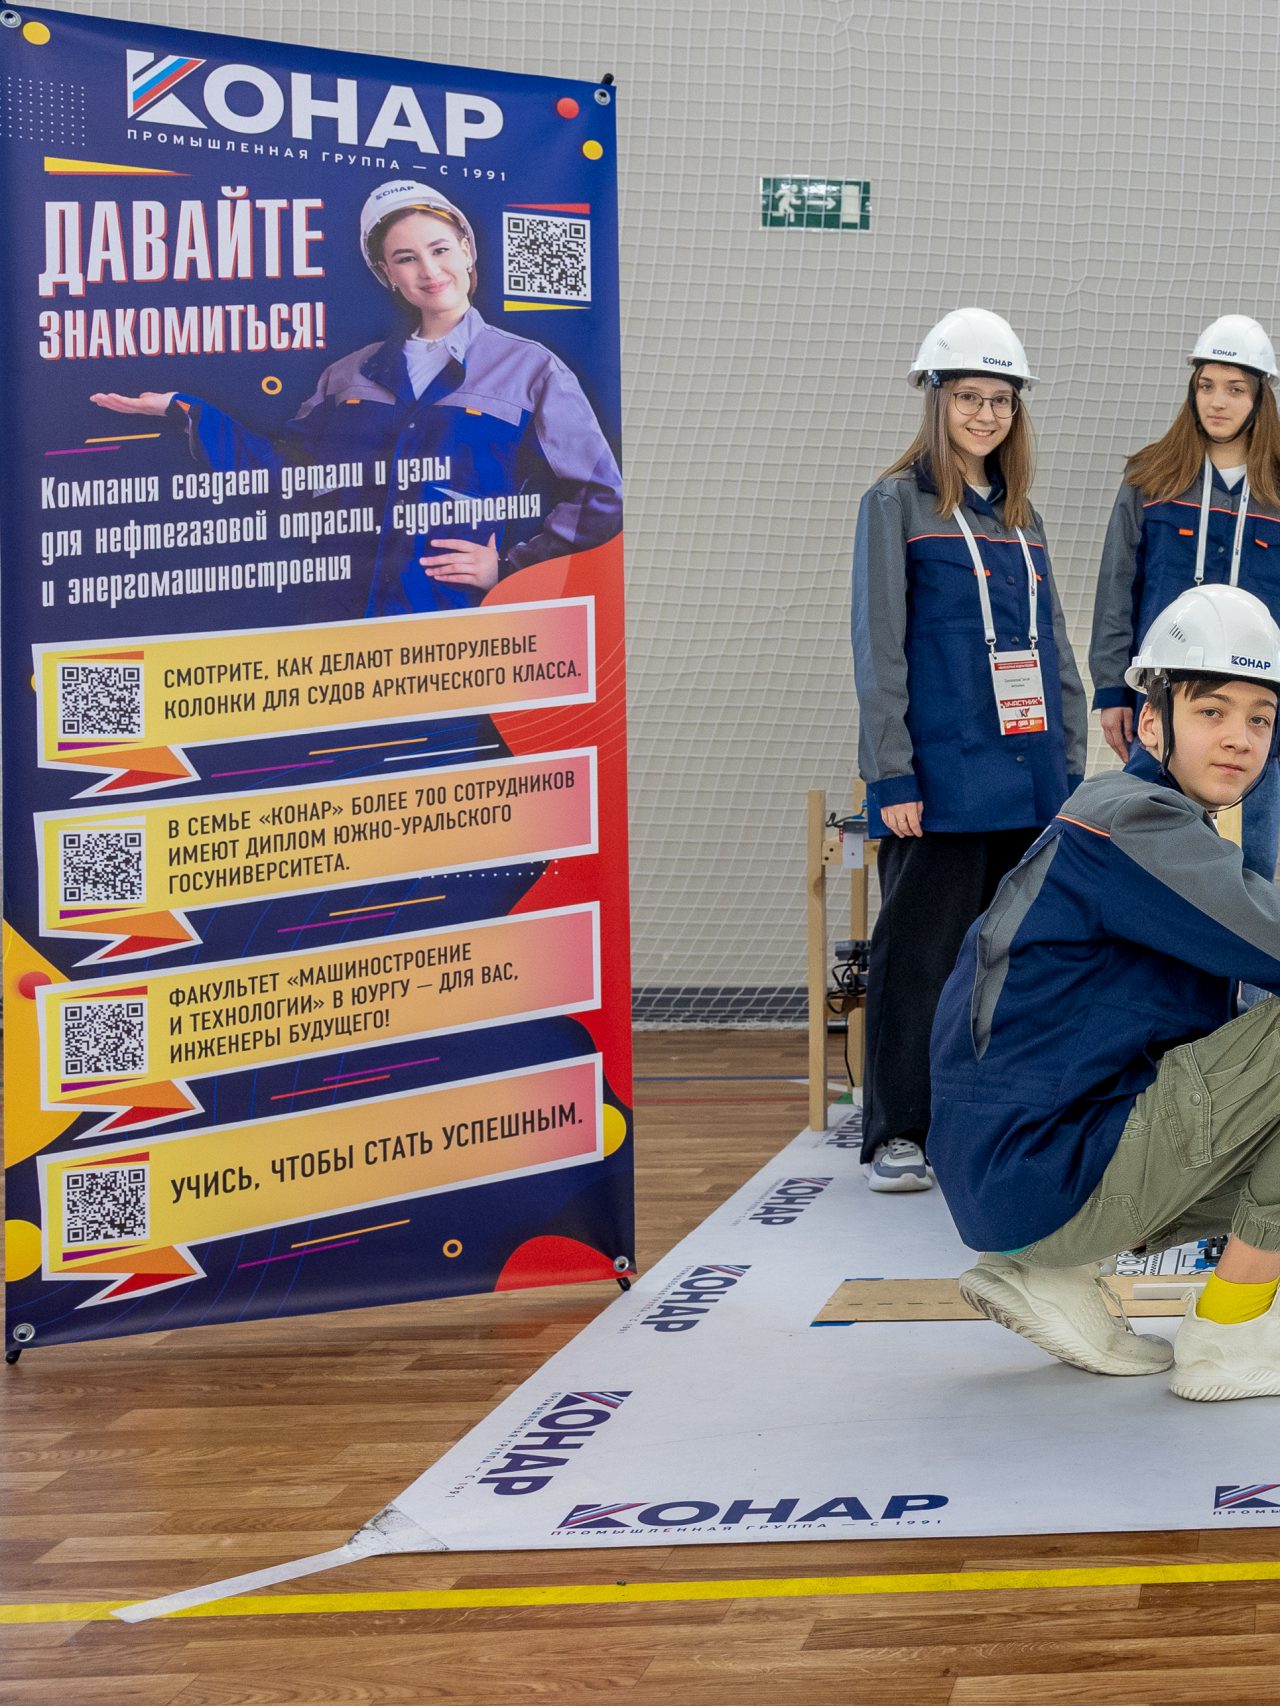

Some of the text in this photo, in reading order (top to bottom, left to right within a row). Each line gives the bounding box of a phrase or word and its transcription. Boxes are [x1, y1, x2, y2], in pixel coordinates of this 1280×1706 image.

[126, 49, 504, 158] КОНАР
[127, 129, 309, 160] ПРОМЫШЛЕННАЯ
[322, 152, 400, 170] ГРУППА
[439, 164, 449, 175] С
[463, 167, 505, 182] 1991
[38, 185, 325, 299] ДАВАЙТЕ
[38, 302, 326, 360] ЗНАКОМИТЬСЯ!
[982, 356, 1013, 367] КОНАР
[41, 455, 451, 510] Компания создает детали и узлы
[41, 493, 541, 566] для нефтегазовой отрасли, судостроения
[41, 554, 351, 609] и энергомашиностроения
[164, 634, 537, 688] СМОТРИТЕ, КАК ДЕЛАЮТ ВИНТОРУЛЕВЫЕ
[1231, 654, 1272, 670] КОНАР
[164, 659, 583, 720] КОЛОНКИ ДЛЯ СУДОВ АРКТИЧЕСКОГО КЛАССА.
[168, 770, 575, 839] В СЕМЬЕ «КОНАР» БОЛЕЕ 700 СОТРУДНИКОВ
[168, 804, 512, 867] ИМЕЮТ ДИПЛОМ ЮЖНО-УРАЛЬСКОГО
[168, 853, 351, 895] ГОСУНИВЕРСИТЕТА.
[168, 942, 472, 1008] ФАКУЛЬТЕТ «МАШИНОСТРОЕНИЕ
[170, 1016, 182, 1036] И
[189, 994, 325, 1032] ТЕХНОЛОГИИ»
[333, 990, 344, 1009] В
[351, 979, 410, 1006] ЮУРГУ
[439, 968, 474, 994] ДЛЯ
[481, 962, 519, 985] ВАС,
[170, 1008, 391, 1064] ИНЖЕНЕРЫ БУДУЩЕГО!
[170, 1101, 584, 1204] УЧИСЬ, ЧТОБЫ СТАТЬ УСПЕШНЫМ.
[749, 1177, 835, 1226] КОНАР
[640, 1264, 753, 1333] КОНАР
[477, 1390, 634, 1496] КОНАР
[480, 1439, 513, 1464] ГРУППА
[444, 1482, 469, 1499] 1991
[556, 1494, 950, 1530] КОНАР
[550, 1525, 733, 1537] ПРОМЫШЛЕННАЯ
[745, 1522, 828, 1531] ГРУППА
[895, 1518, 943, 1527] 1991
